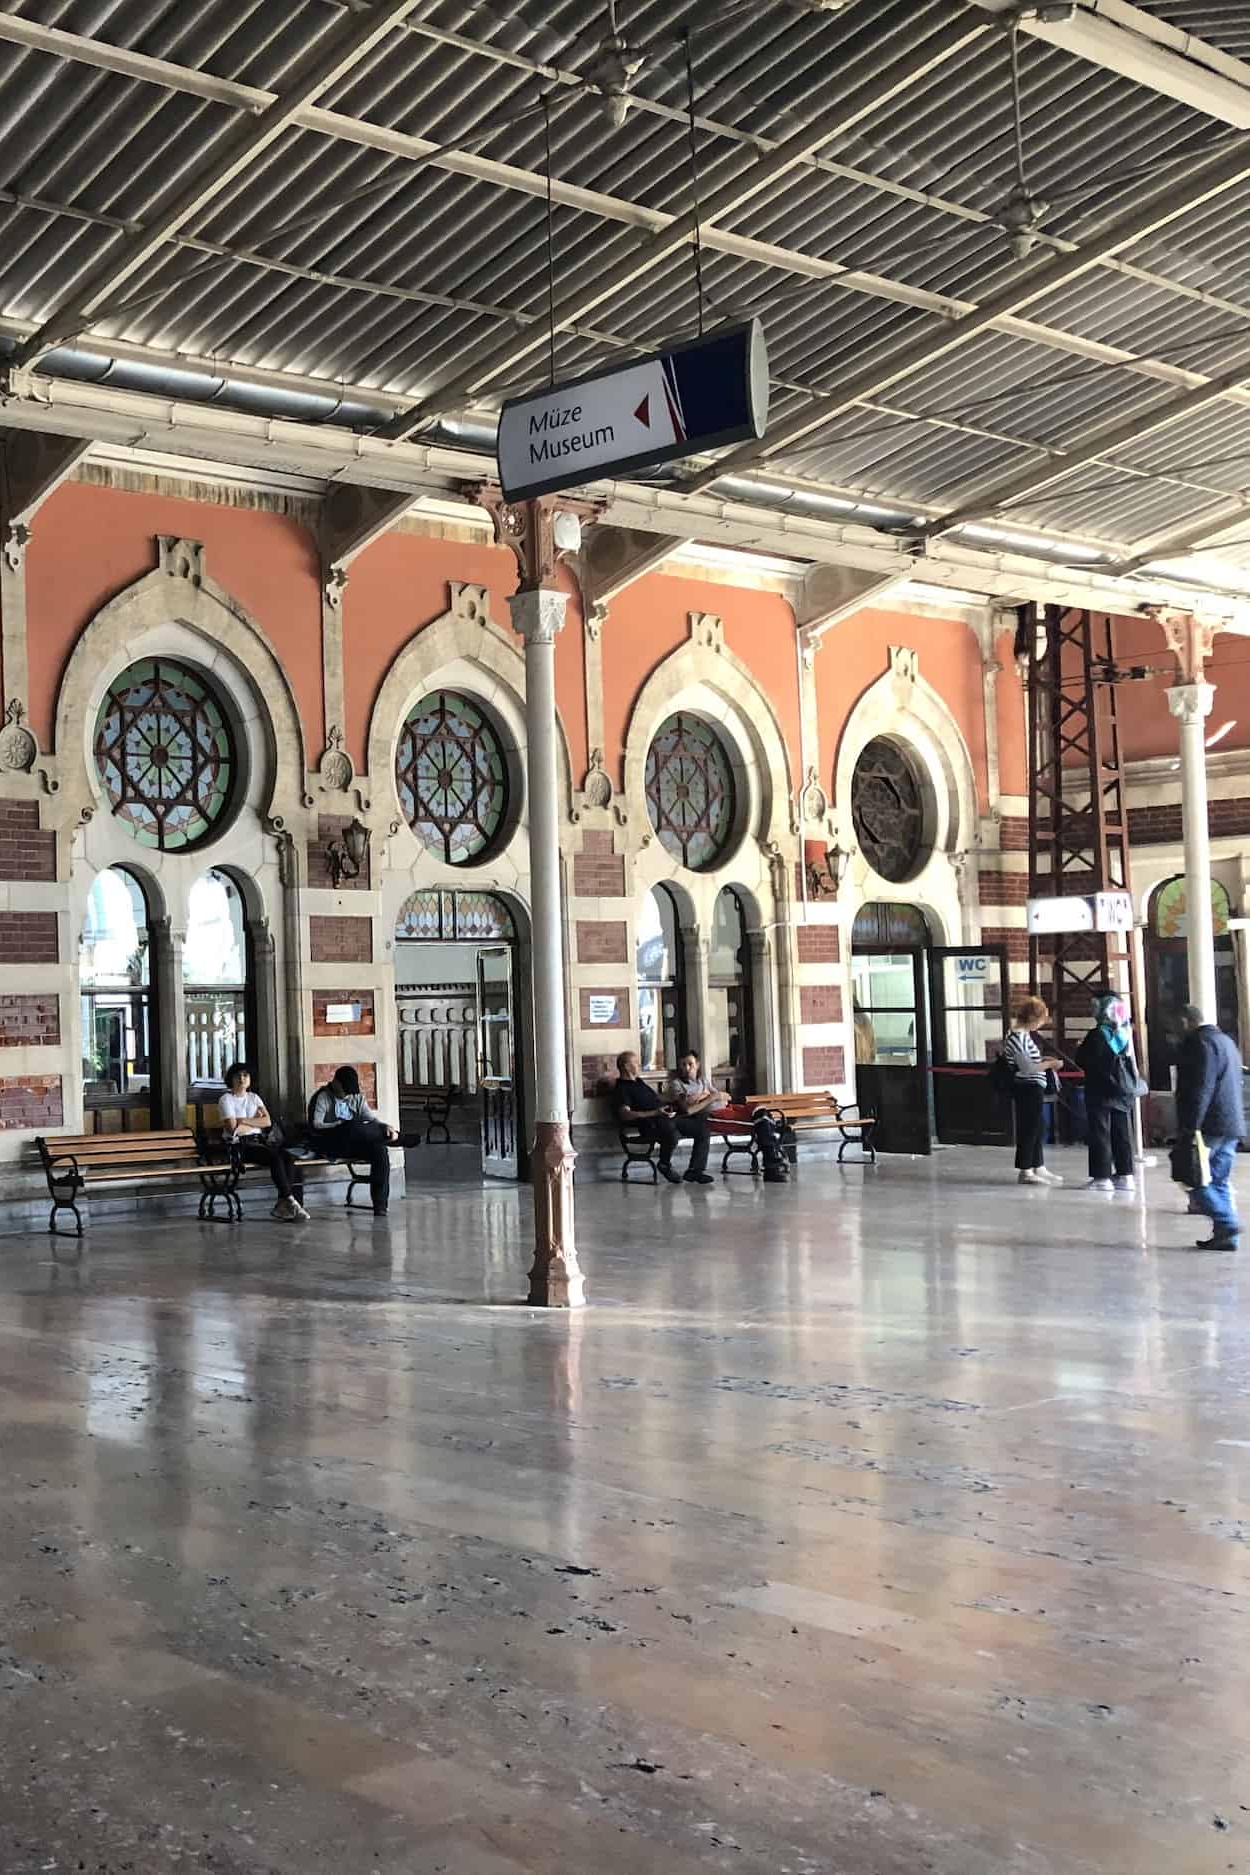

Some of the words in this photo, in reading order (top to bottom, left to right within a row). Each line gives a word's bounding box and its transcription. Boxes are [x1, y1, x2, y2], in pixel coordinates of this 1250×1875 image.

[529, 405, 582, 435] Müze
[529, 425, 615, 465] Museum
[959, 959, 986, 971] WC
